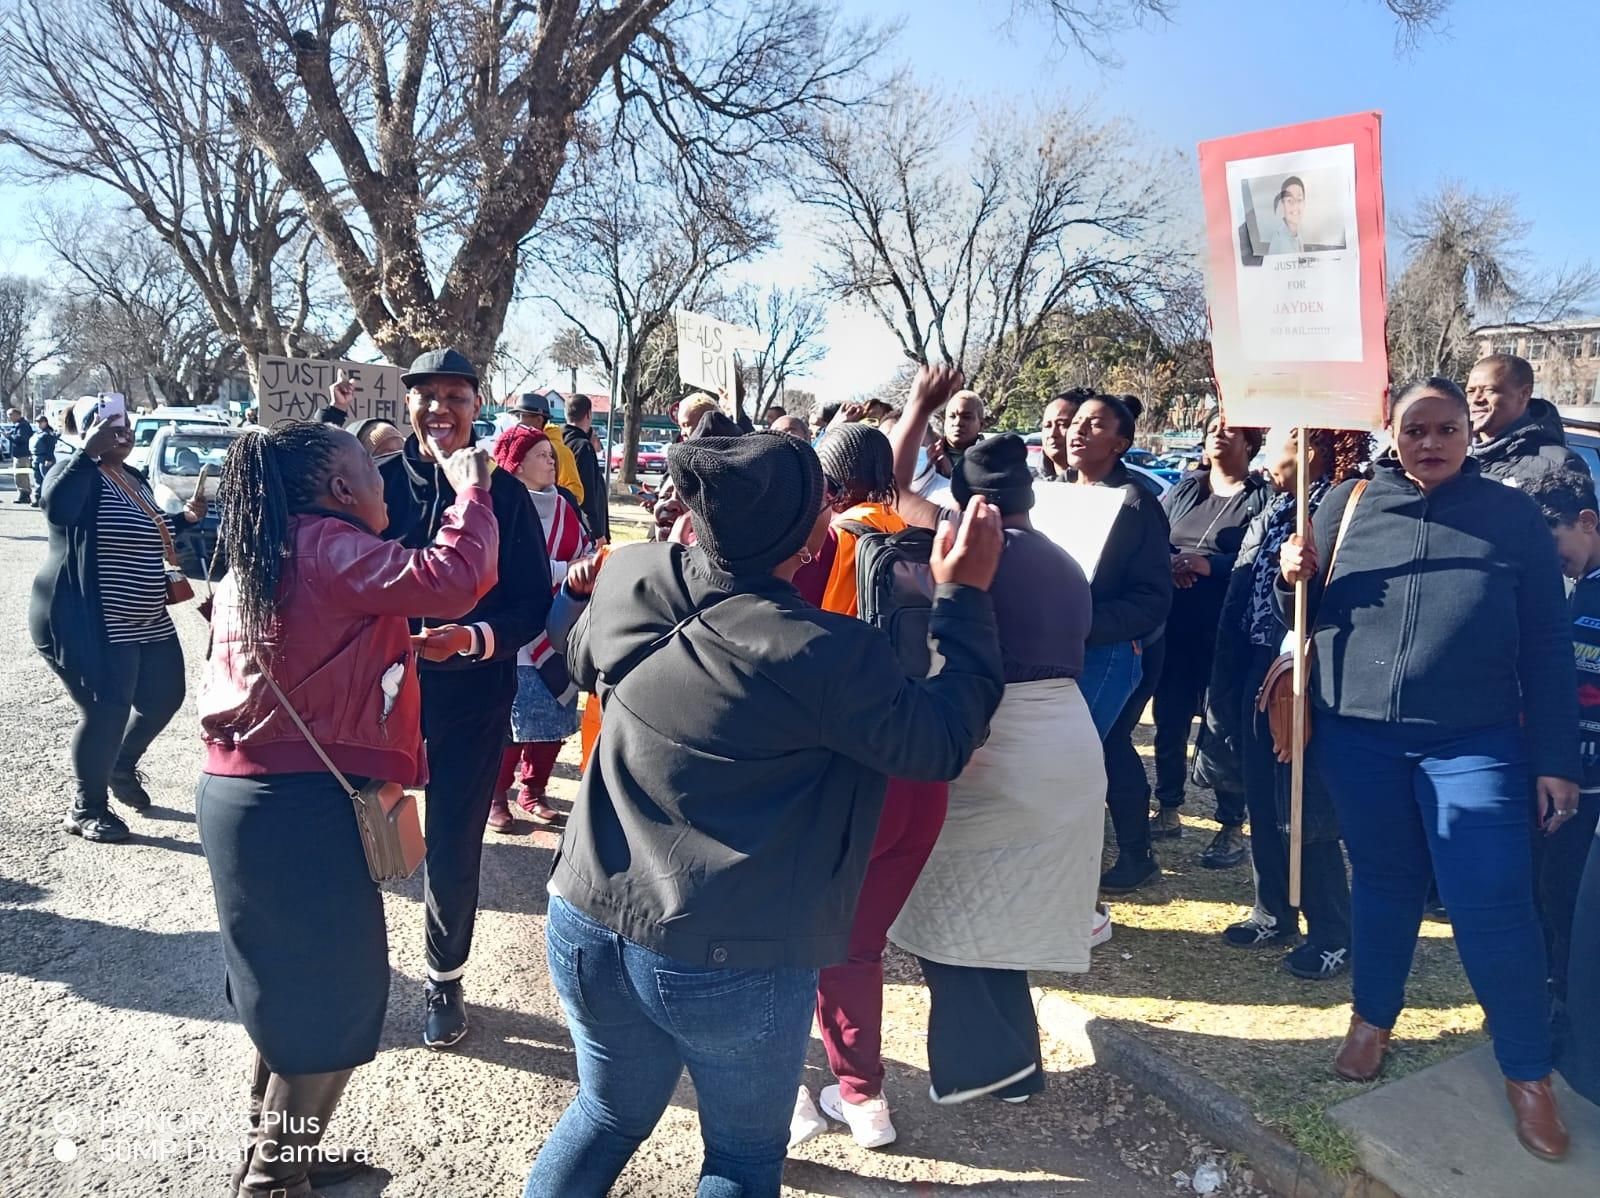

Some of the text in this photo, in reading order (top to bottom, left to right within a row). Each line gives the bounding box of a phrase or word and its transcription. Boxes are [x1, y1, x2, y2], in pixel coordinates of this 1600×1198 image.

[1287, 279, 1306, 289] FOR
[1273, 300, 1324, 314] JAYDEN
[679, 314, 723, 353] HEADS
[374, 373, 387, 398] 4
